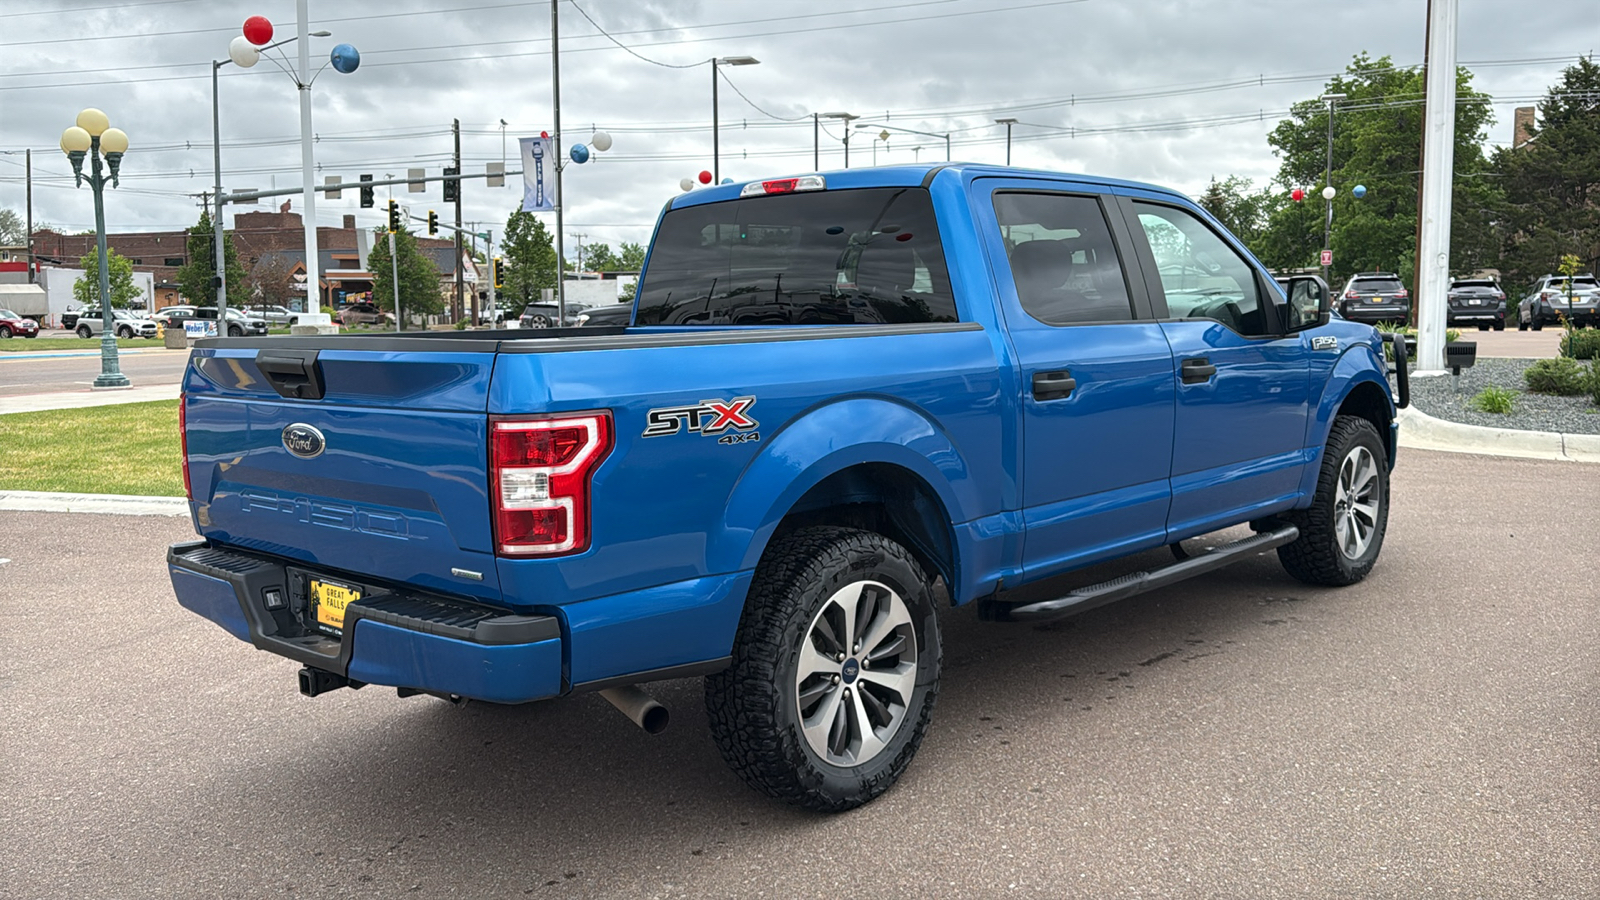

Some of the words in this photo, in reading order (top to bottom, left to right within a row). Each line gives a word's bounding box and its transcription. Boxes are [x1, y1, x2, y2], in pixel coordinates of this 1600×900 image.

[186, 323, 203, 332] Weber
[642, 395, 760, 438] STX
[289, 430, 312, 451] Ford
[240, 488, 409, 541] F-150
[327, 588, 344, 600] GREAT
[327, 598, 345, 610] FALLS
